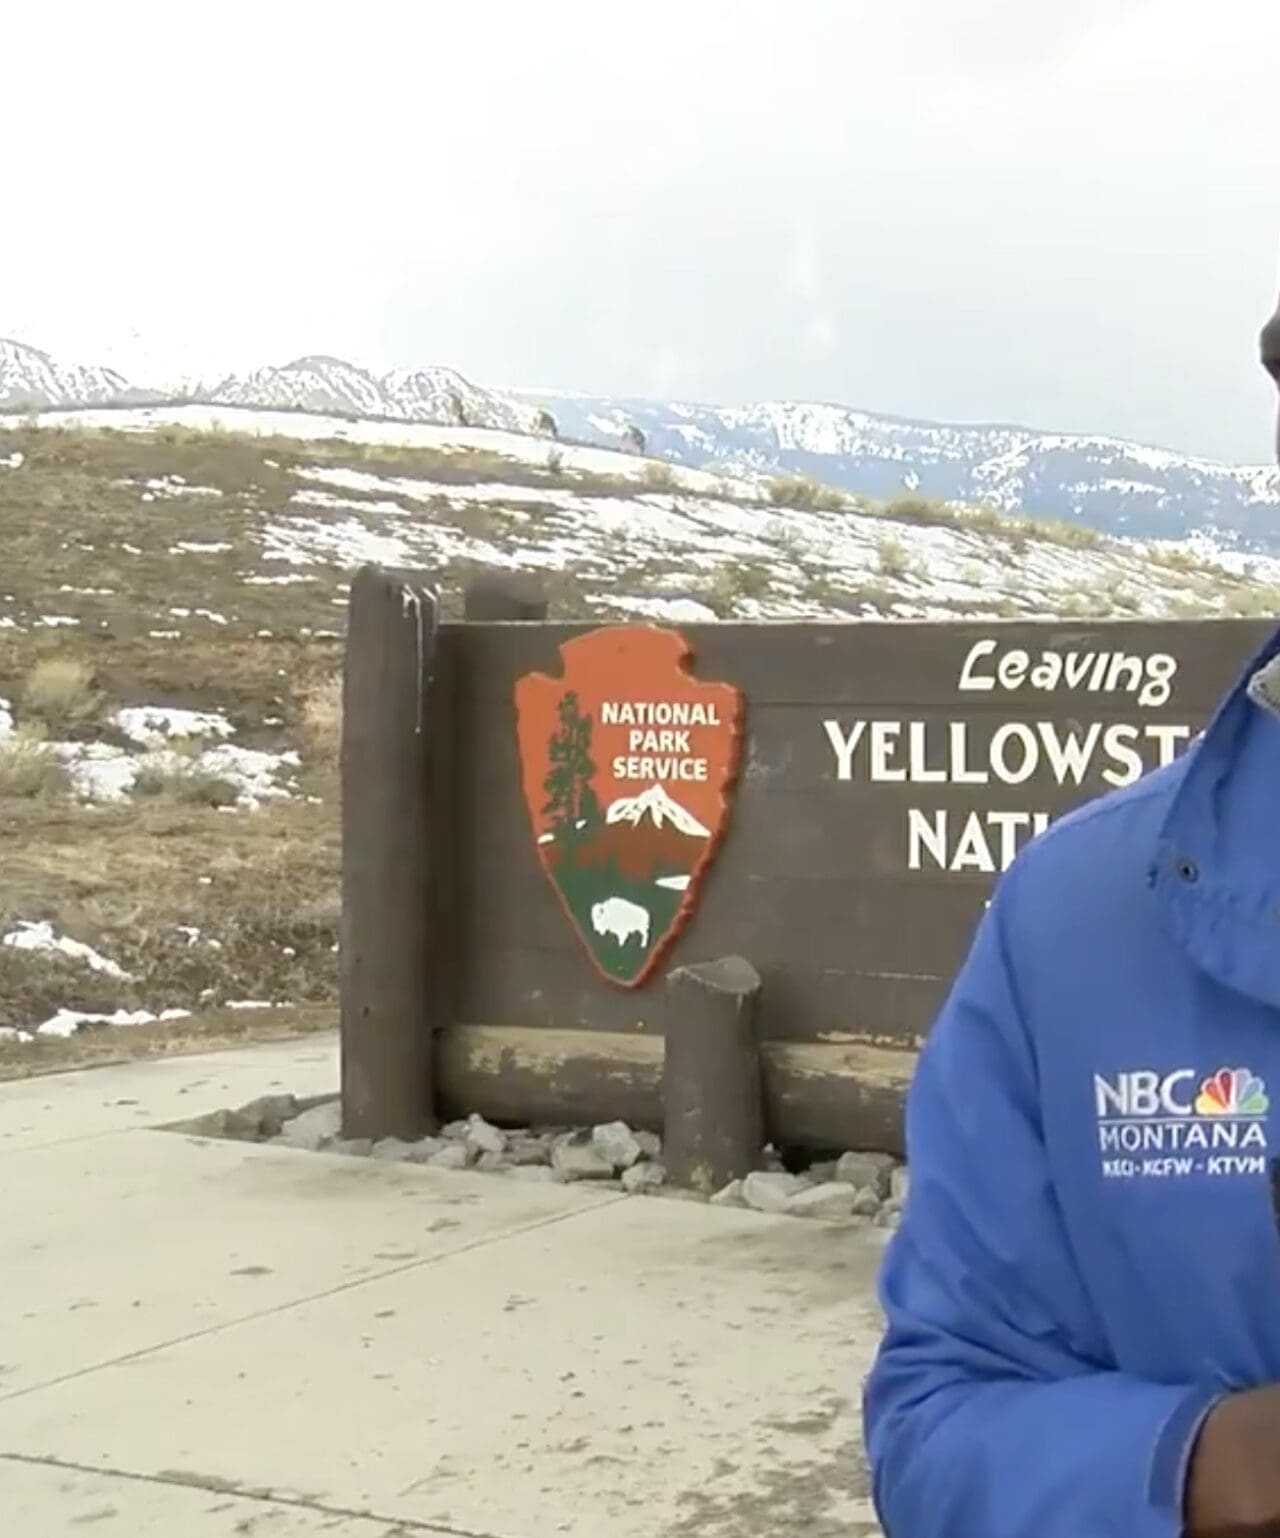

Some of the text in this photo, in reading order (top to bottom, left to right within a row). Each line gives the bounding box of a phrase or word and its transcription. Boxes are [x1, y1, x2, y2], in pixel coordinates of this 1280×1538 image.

[957, 639, 1177, 706] Leaving
[601, 702, 720, 726] NATIONAL
[629, 730, 690, 753] PARK
[823, 720, 1206, 787] YELLOWST
[612, 756, 708, 781] SERVICE
[1094, 1069, 1196, 1117] NBC
[1099, 1121, 1268, 1152] MONTANA
